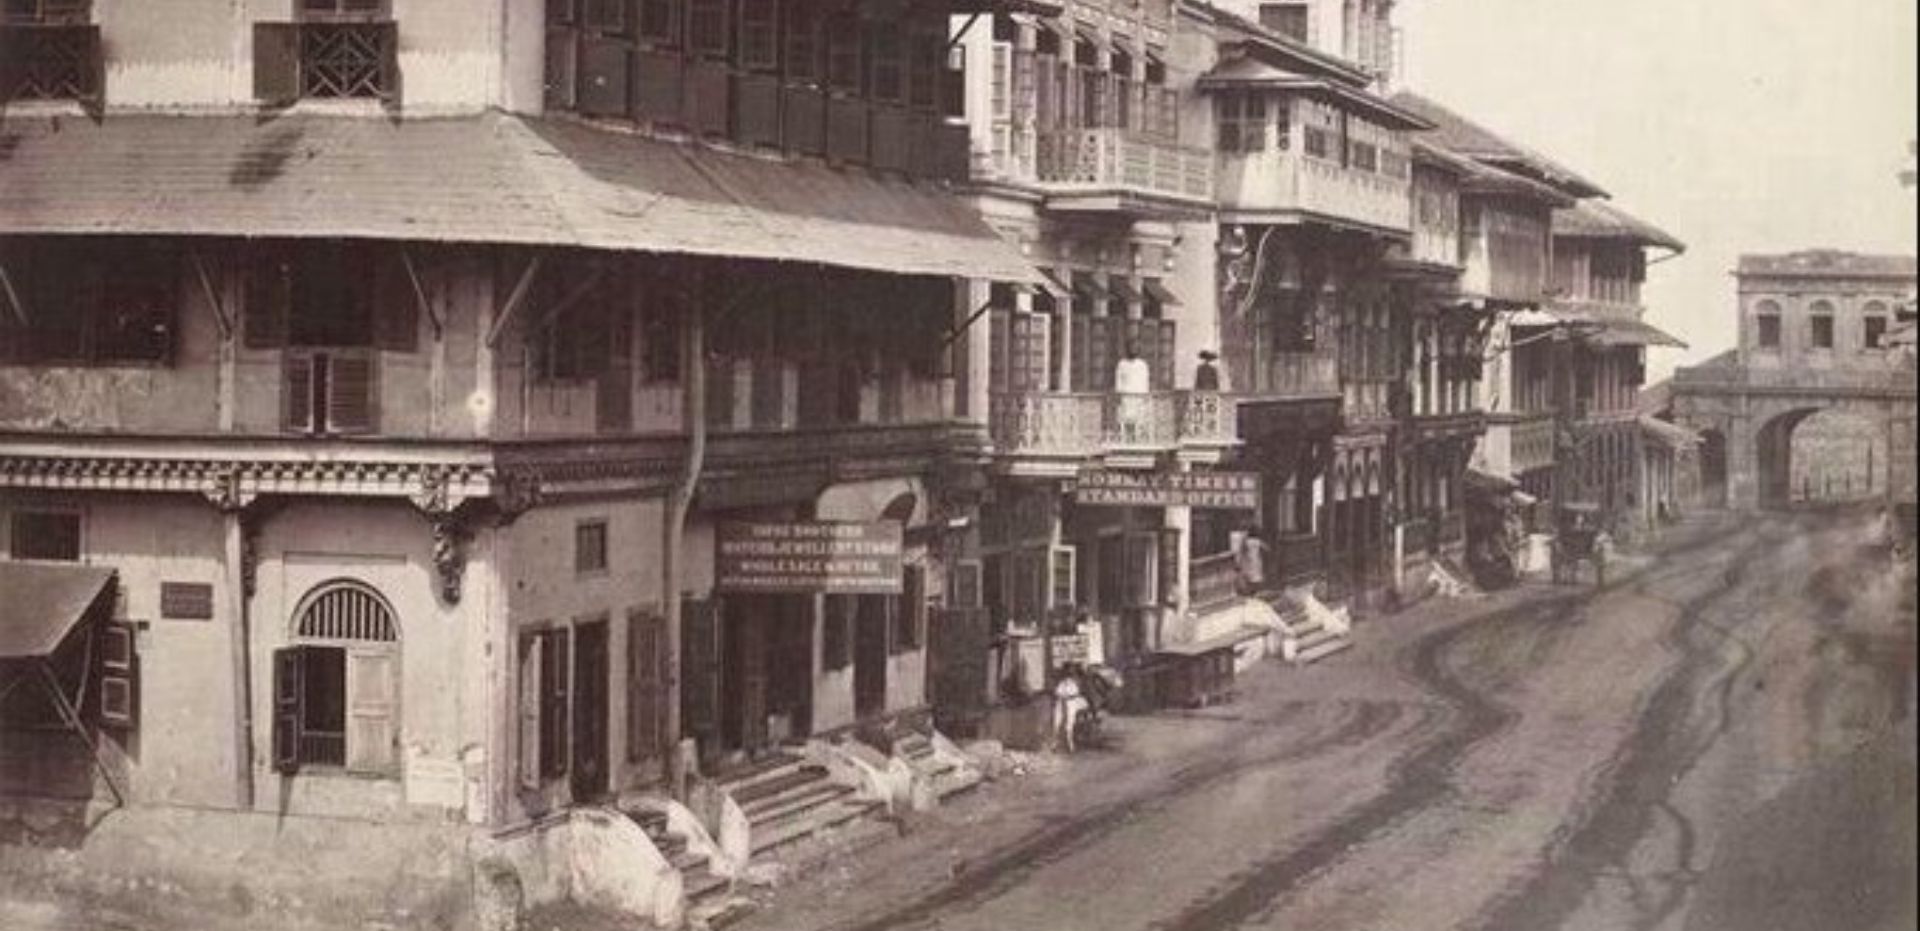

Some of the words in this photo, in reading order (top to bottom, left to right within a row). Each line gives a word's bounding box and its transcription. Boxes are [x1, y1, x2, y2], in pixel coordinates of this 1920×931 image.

[1077, 472, 1163, 488] BOMBAY
[1168, 474, 1237, 490] TIMES
[1076, 488, 1183, 504] STANDARD
[1187, 490, 1257, 507] OFFICE
